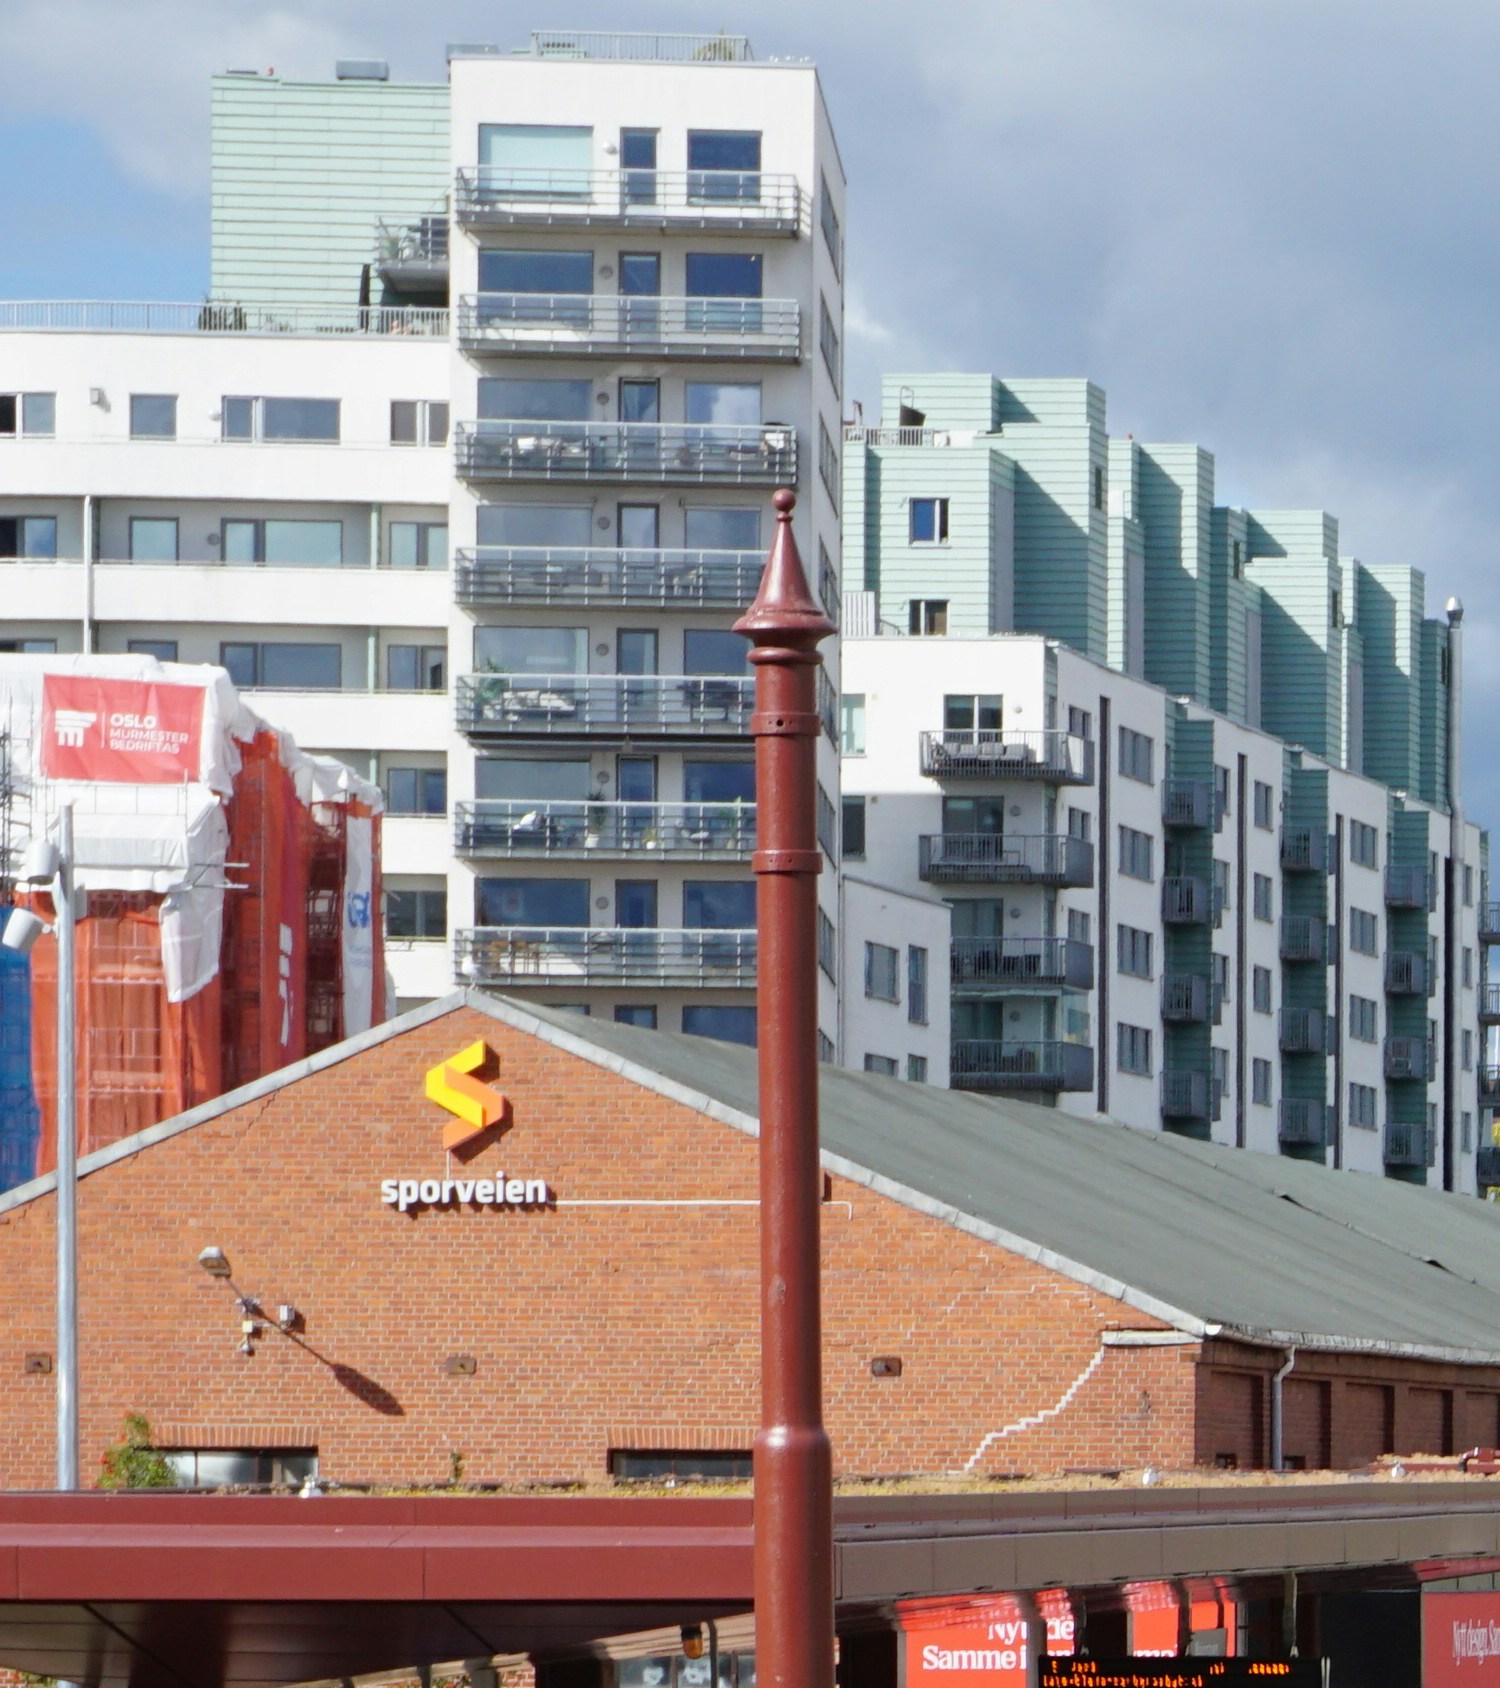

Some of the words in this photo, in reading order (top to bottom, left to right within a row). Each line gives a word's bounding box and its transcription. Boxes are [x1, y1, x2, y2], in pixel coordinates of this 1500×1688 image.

[110, 713, 157, 728] OSLO
[109, 727, 188, 744] MURMESTER
[381, 1170, 547, 1212] sporveien
[923, 1645, 1016, 1670] Samme
